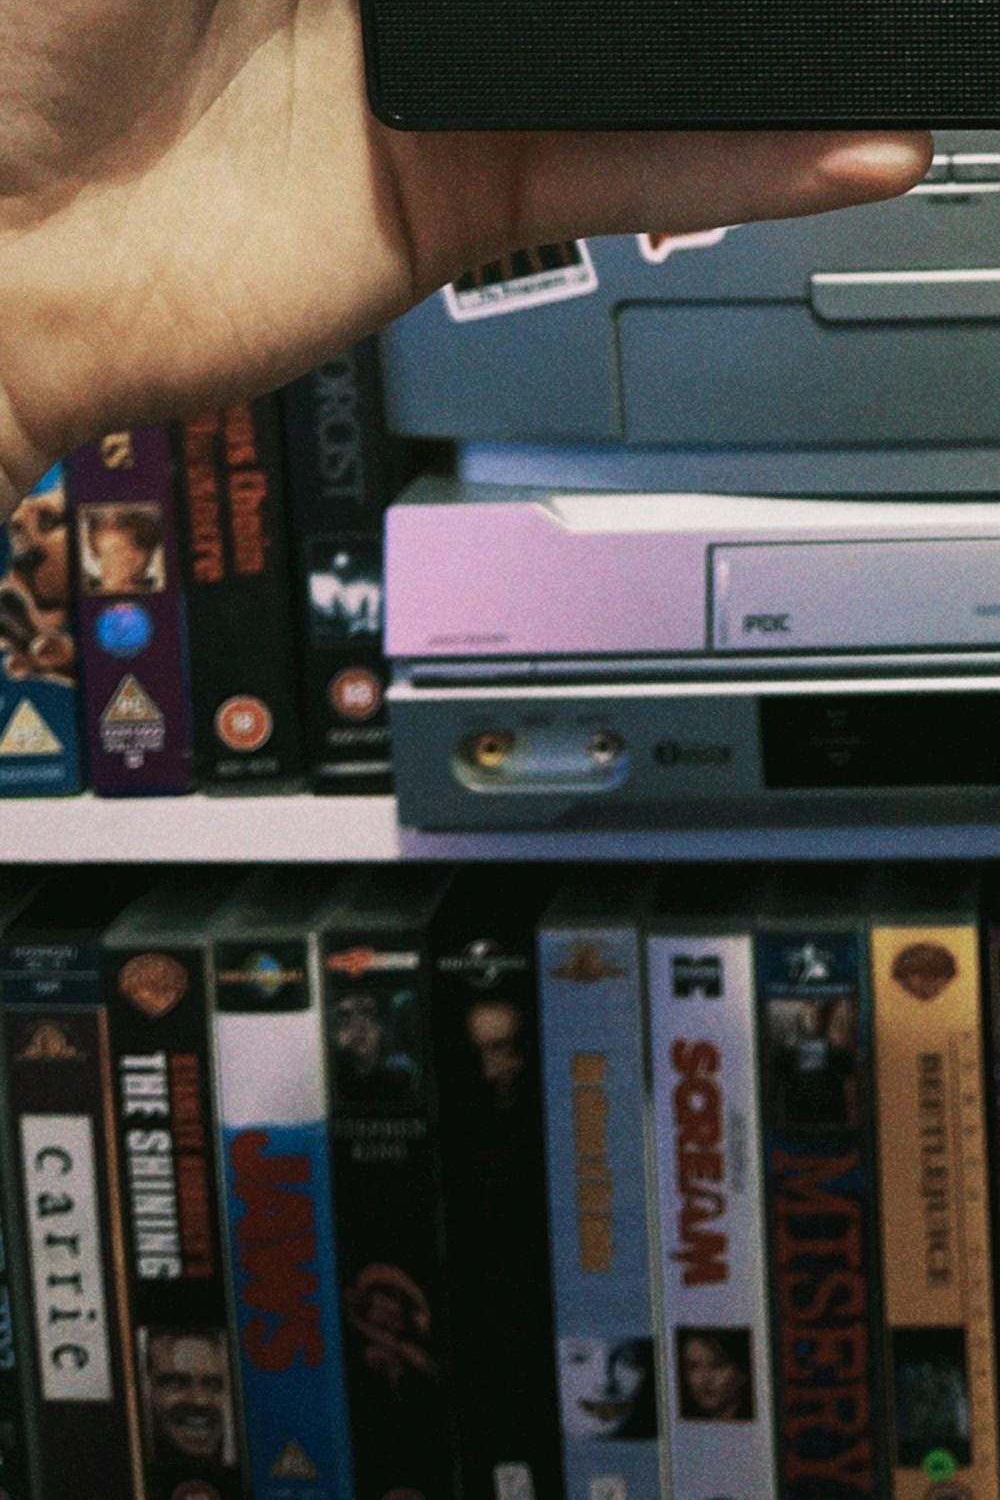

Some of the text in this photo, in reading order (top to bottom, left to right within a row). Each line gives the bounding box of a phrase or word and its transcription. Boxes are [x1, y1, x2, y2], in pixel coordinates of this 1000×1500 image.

[34, 1145, 99, 1373] carrie
[118, 1051, 182, 1281] THE SHINING
[228, 1130, 326, 1373] JAWS
[669, 1038, 729, 1289] SCREAM
[770, 1147, 875, 1493] MISERY
